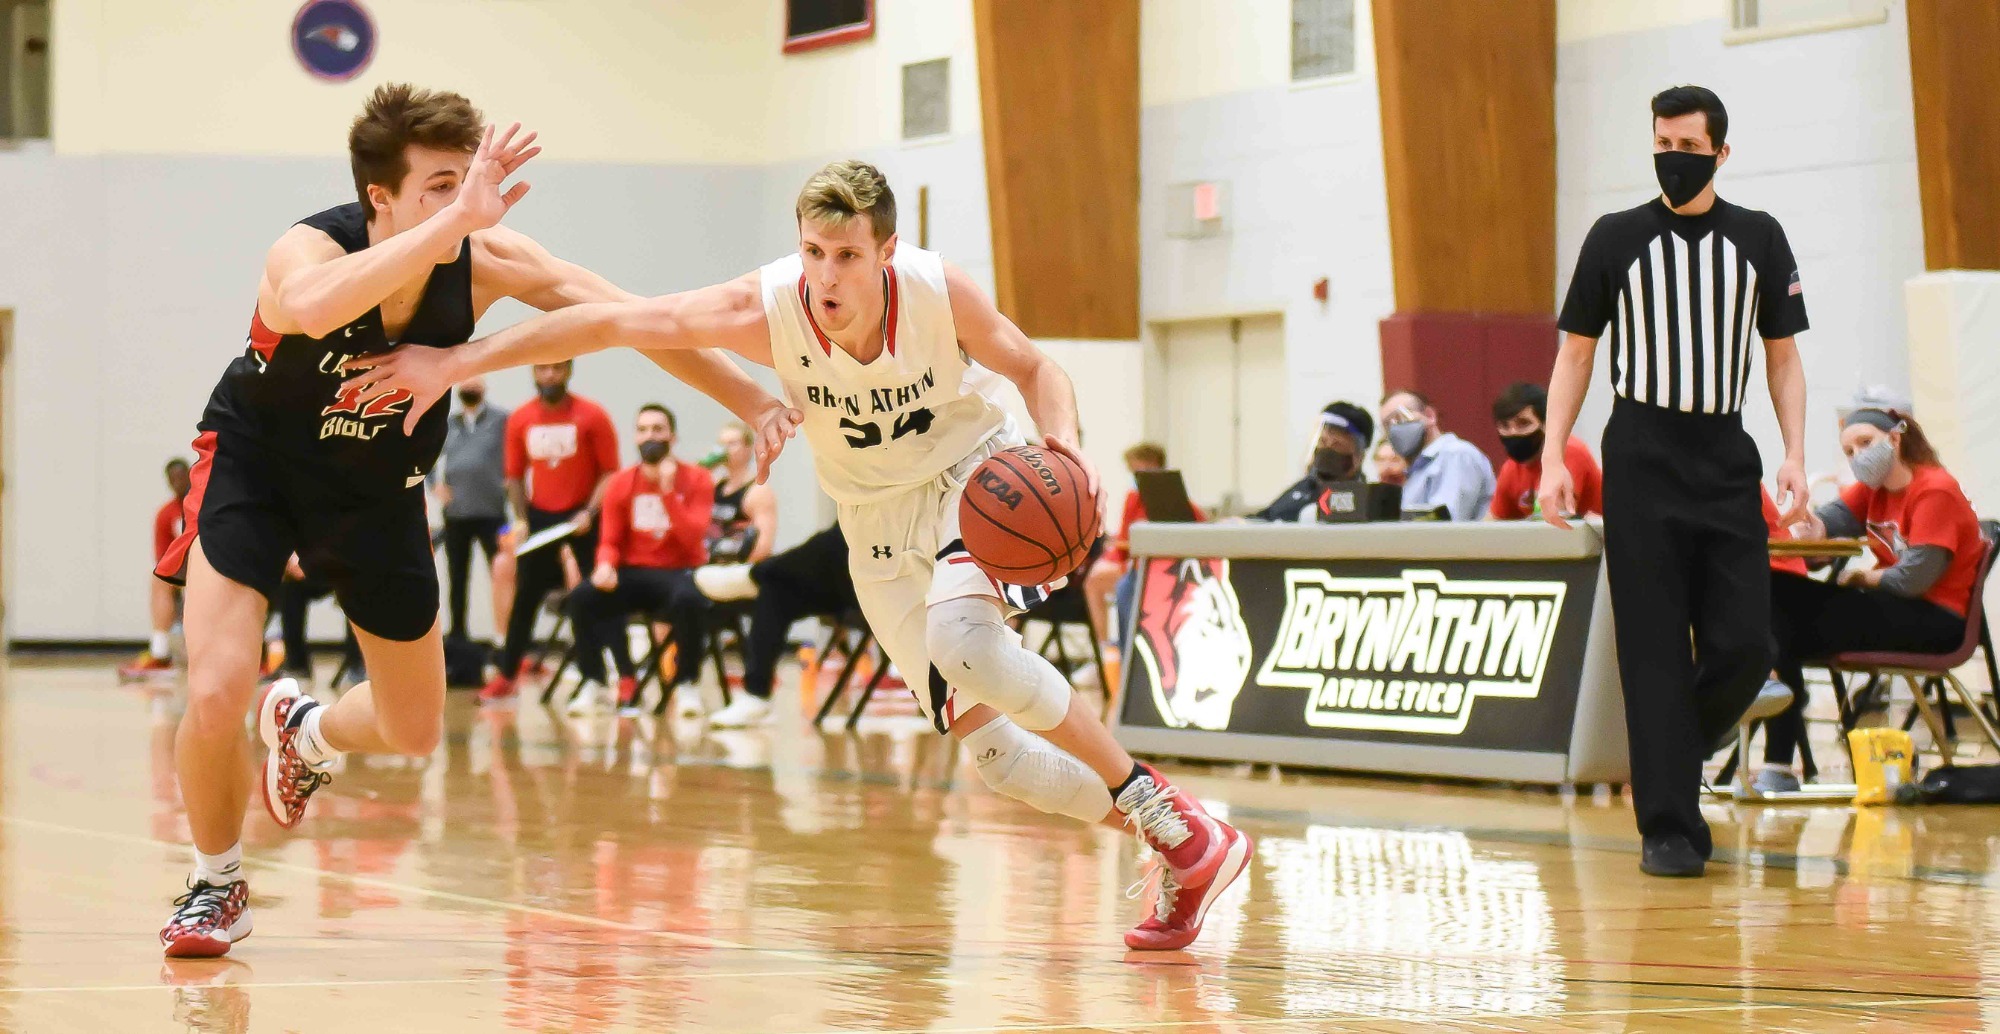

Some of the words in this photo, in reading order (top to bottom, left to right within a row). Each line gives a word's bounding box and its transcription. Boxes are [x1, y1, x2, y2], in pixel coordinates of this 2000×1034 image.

[807, 385, 861, 417] BRN
[869, 366, 935, 415] ATHYN
[973, 466, 1024, 511] NCAA
[1277, 587, 1405, 672] BRYN
[1390, 588, 1553, 678] ATHYN
[1318, 676, 1465, 714] ATHLETICS
